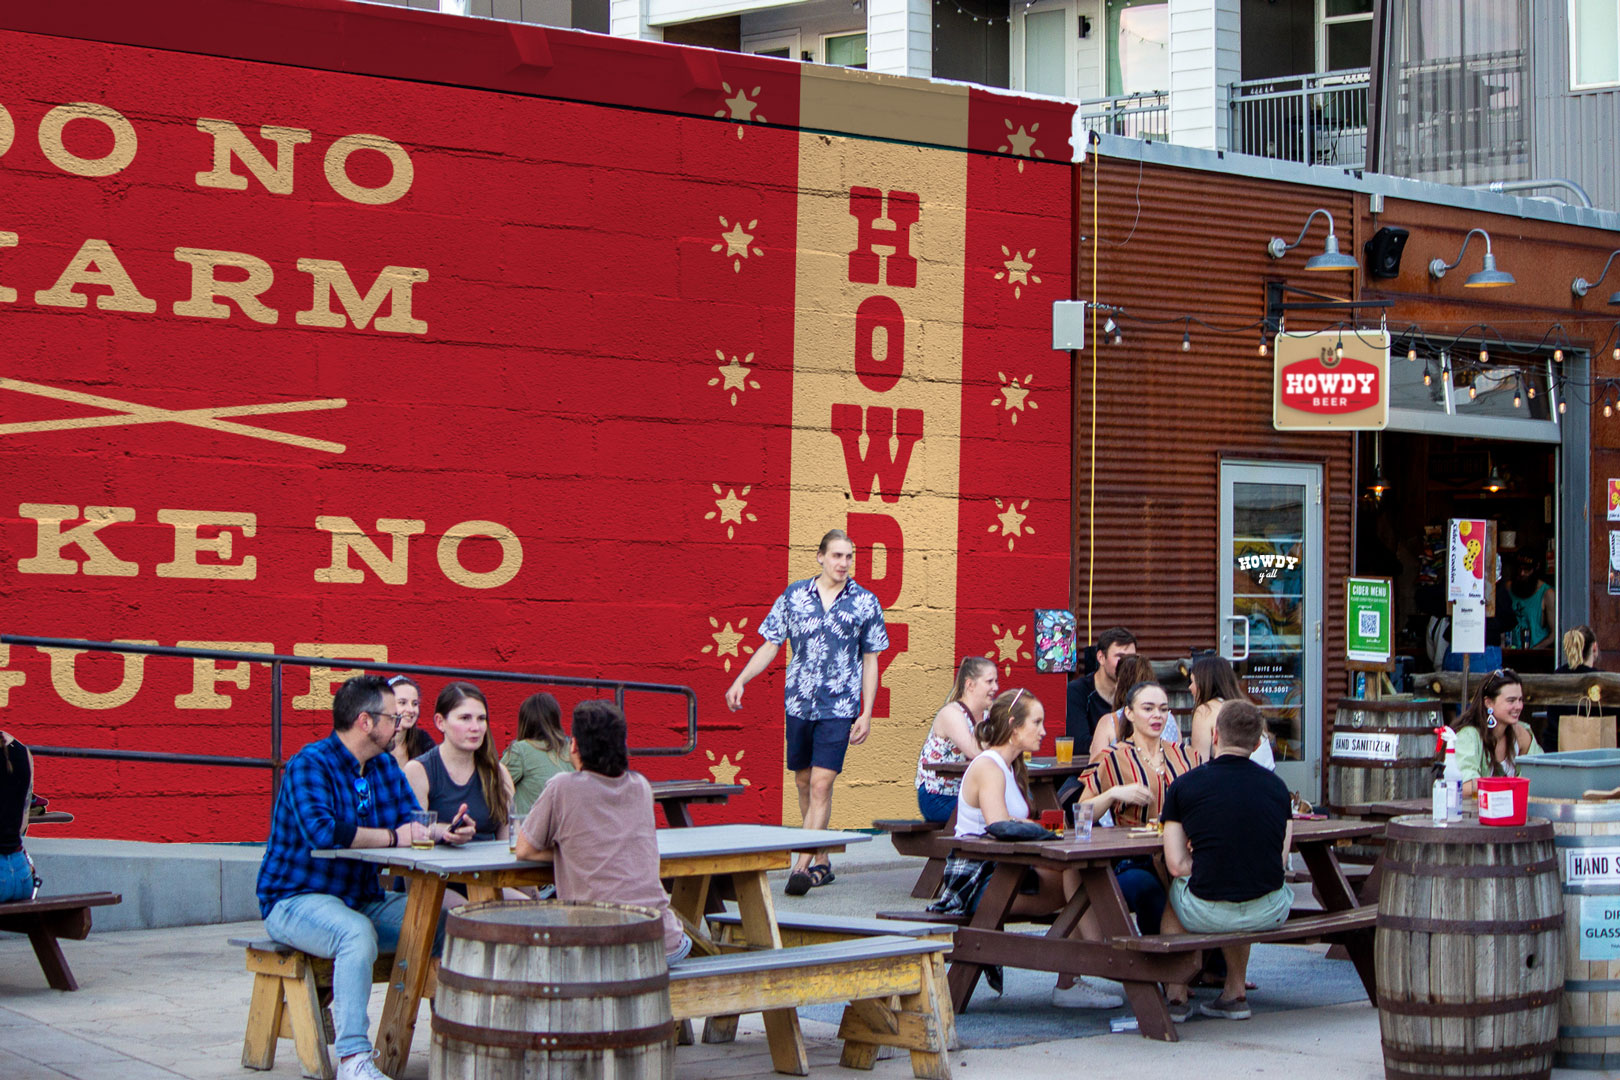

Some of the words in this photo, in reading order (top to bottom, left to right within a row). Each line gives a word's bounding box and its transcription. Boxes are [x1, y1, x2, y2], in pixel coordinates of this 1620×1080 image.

[0, 101, 138, 178] O
[195, 117, 414, 205] NO
[0, 230, 430, 335] ARM
[1286, 373, 1375, 395] HOWDY
[1312, 397, 1348, 407] BEER
[314, 515, 524, 590] NO
[1238, 554, 1299, 571] HOWDY
[1258, 568, 1278, 584] y'all
[1352, 584, 1369, 596] CIDER
[1370, 586, 1387, 597] MENU
[0, 637, 389, 710] UFF
[1335, 738, 1350, 750] HAND
[1351, 739, 1390, 752] SANITIZER
[1574, 857, 1609, 875] HAND
